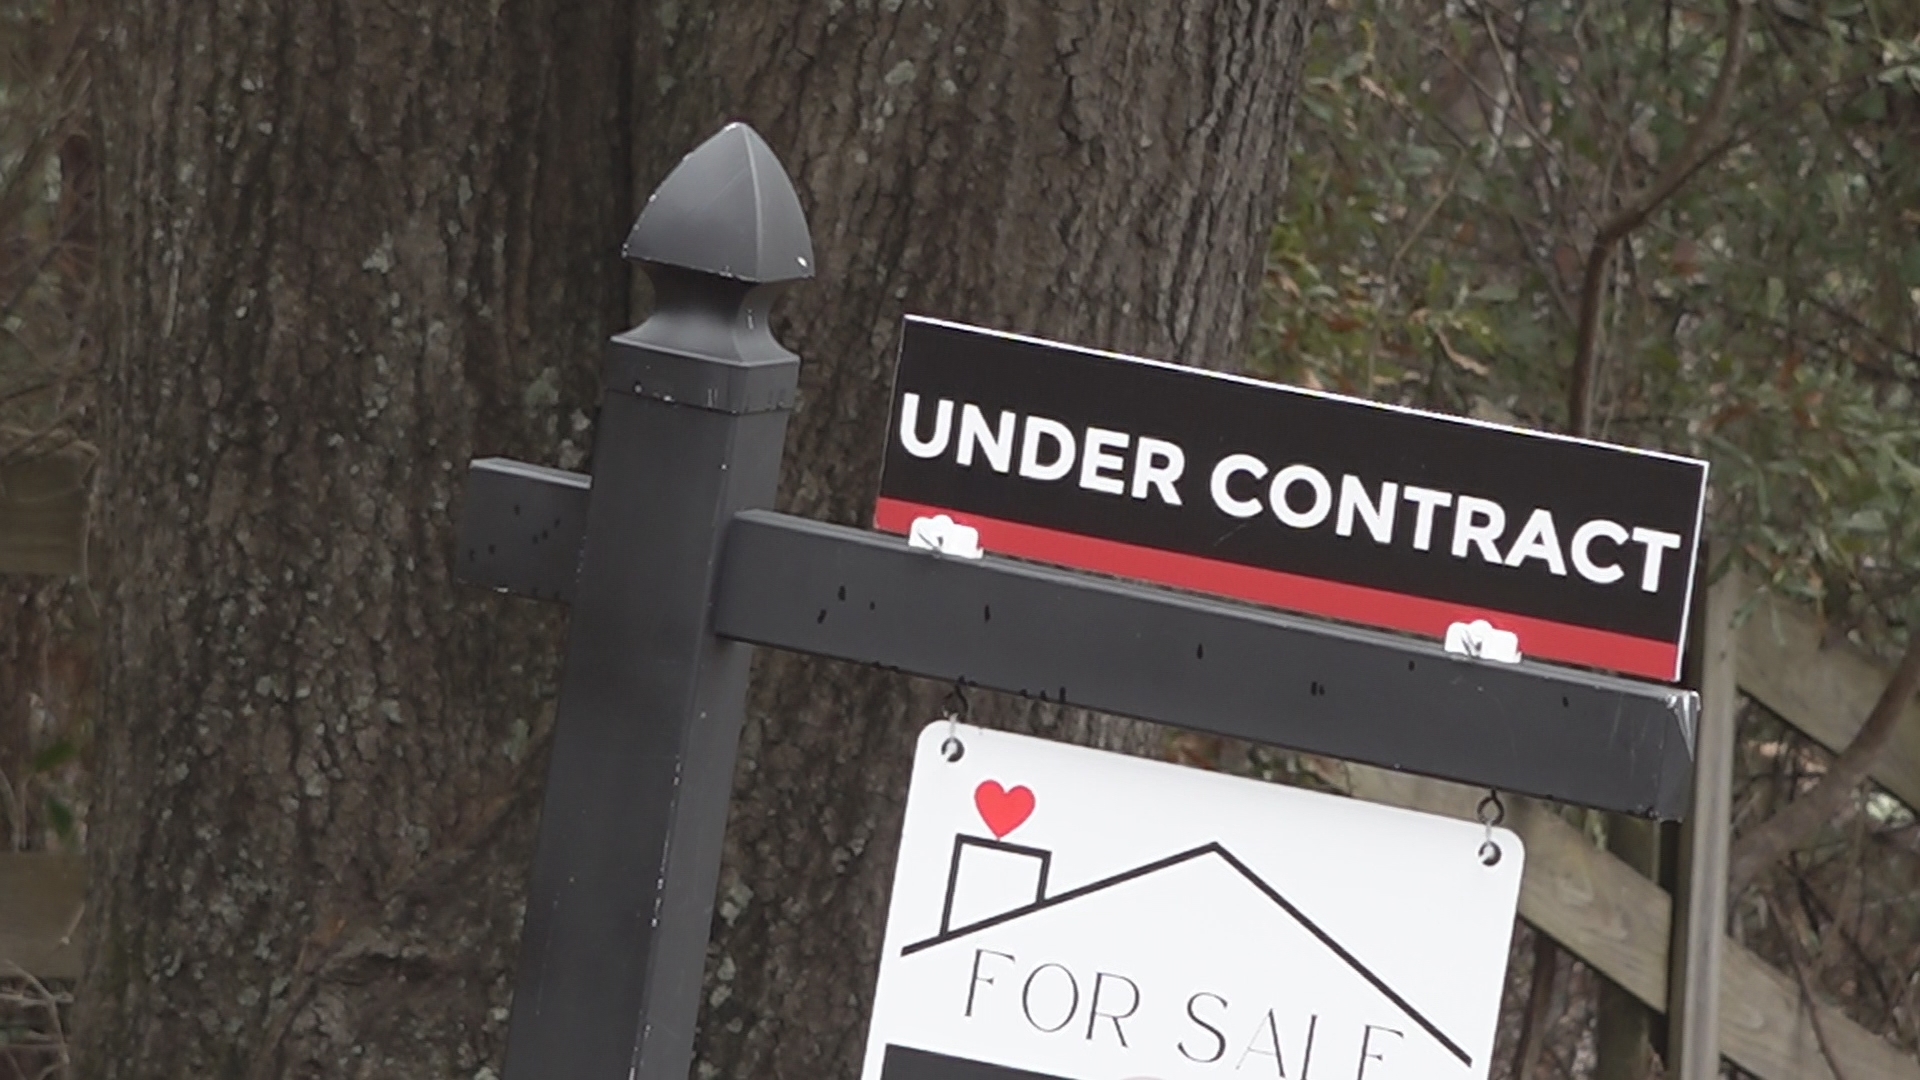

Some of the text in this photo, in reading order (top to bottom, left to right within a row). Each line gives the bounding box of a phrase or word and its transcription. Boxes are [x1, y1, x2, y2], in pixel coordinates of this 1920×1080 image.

[899, 392, 1682, 593] UNDER CONTRACT
[964, 948, 1141, 1049] FOR
